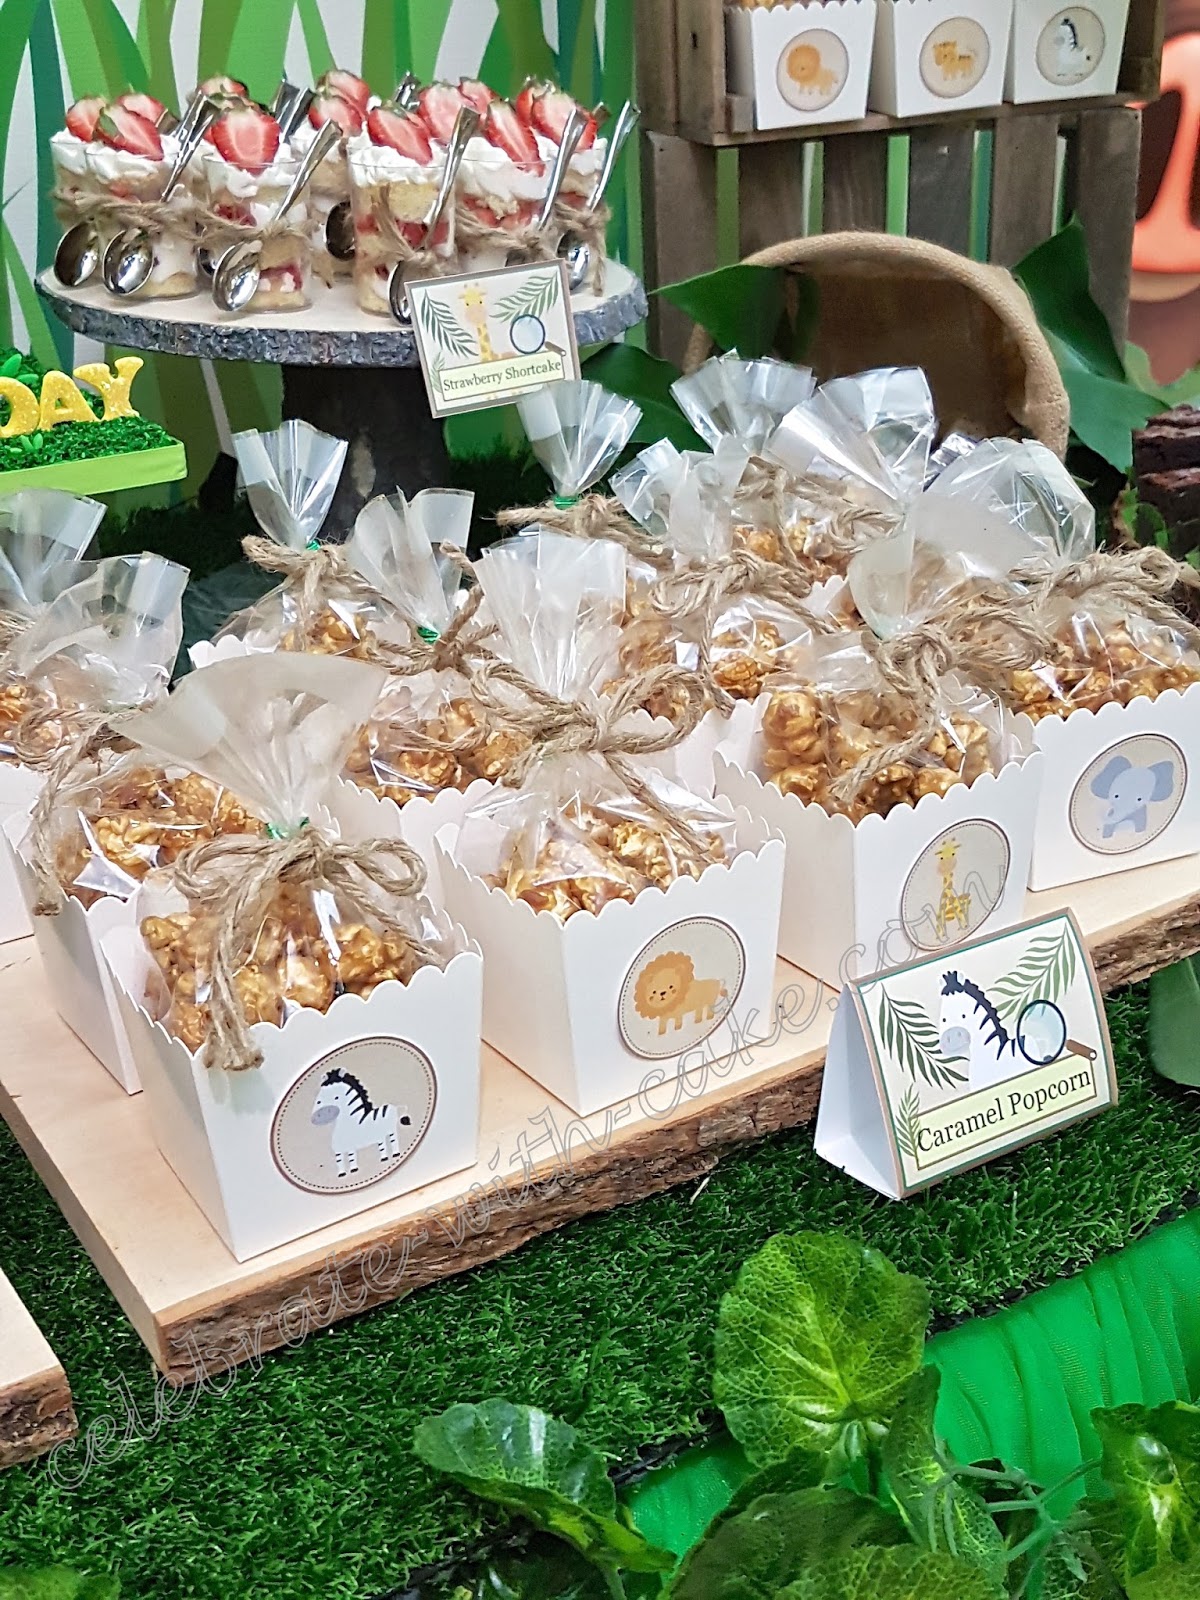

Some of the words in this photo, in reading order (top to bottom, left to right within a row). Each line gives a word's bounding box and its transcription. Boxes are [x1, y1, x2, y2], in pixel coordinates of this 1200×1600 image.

[443, 372, 502, 392] Strawberry
[505, 359, 561, 380] Shortcake
[917, 1098, 1005, 1152] Caramel
[1007, 1070, 1092, 1117] Popcorn
